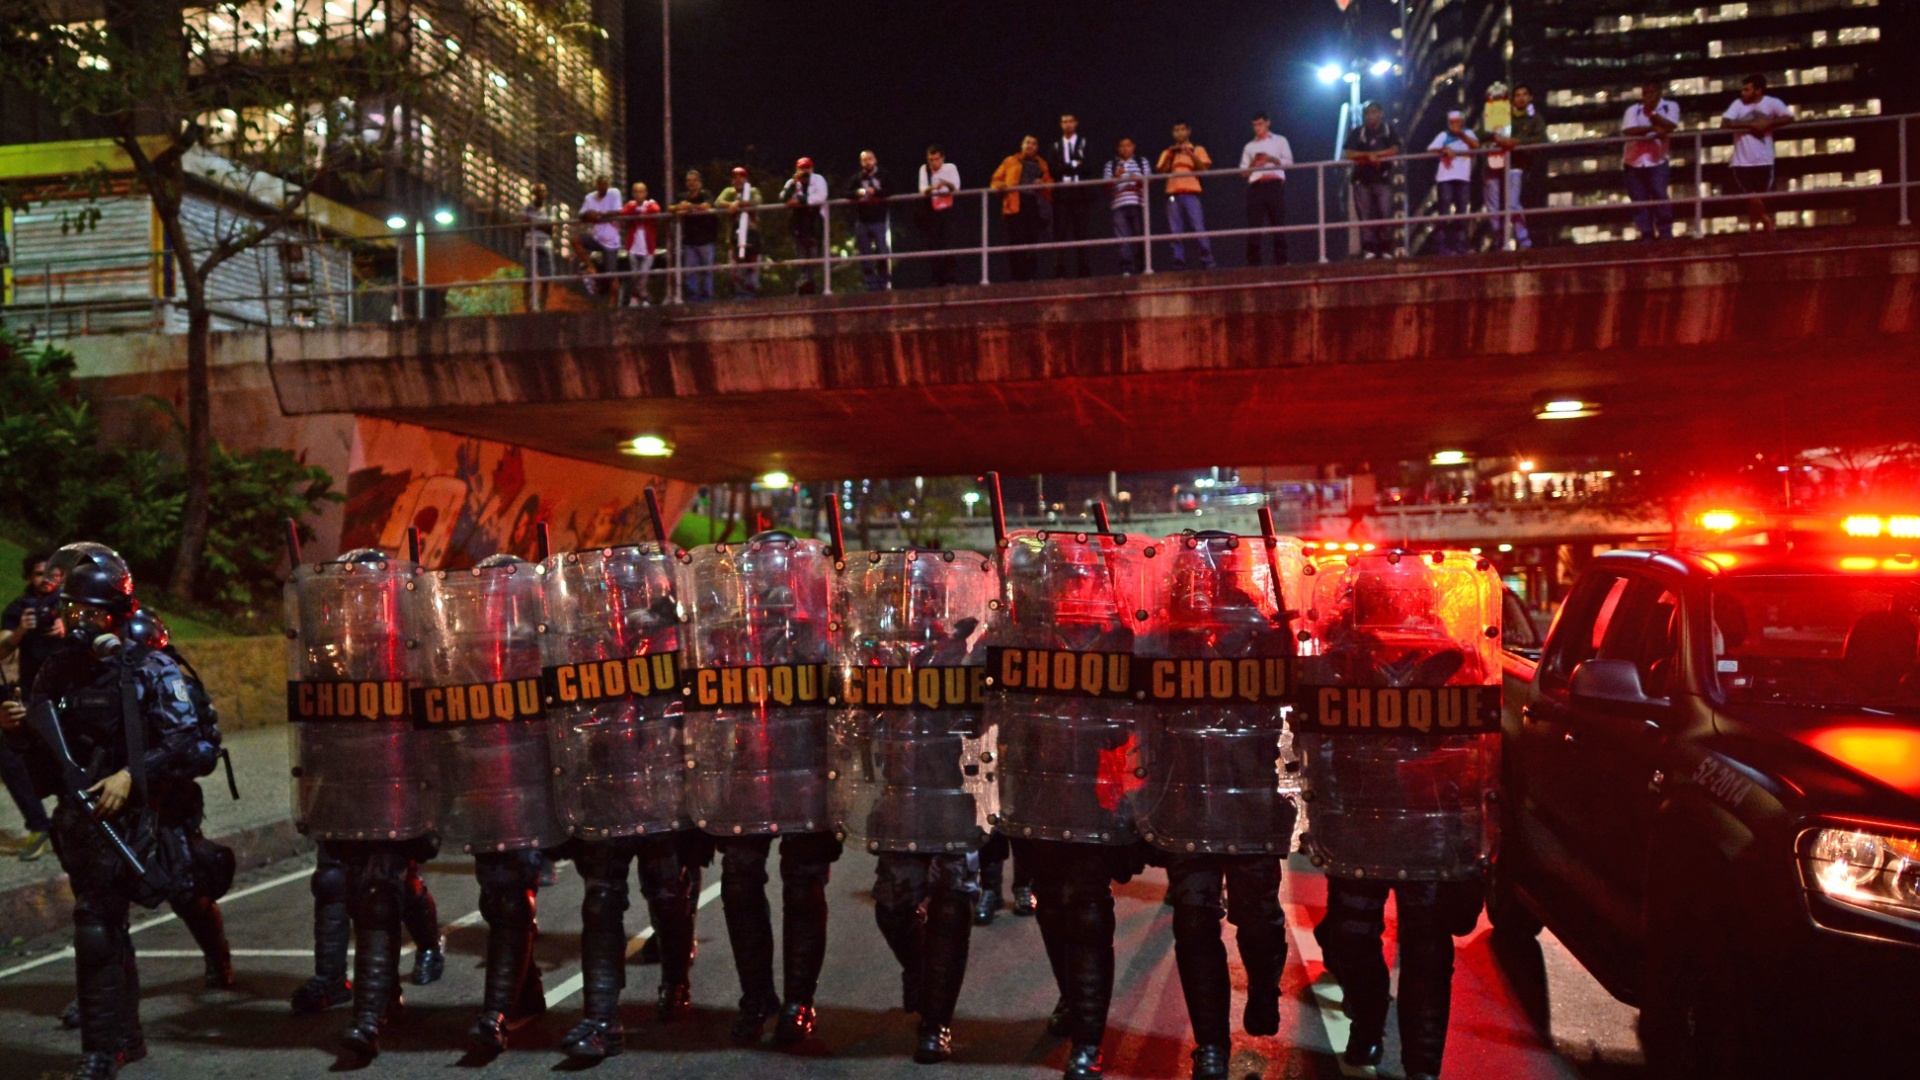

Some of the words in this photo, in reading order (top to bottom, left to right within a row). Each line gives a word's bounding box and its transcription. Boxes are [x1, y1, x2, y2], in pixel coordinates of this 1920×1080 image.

[557, 653, 676, 701] CHOQU
[843, 667, 985, 709] CHOQUE
[1002, 649, 1130, 696] CHOQU
[1153, 659, 1286, 701] CHOQU
[299, 682, 411, 720] CHOQU
[425, 679, 539, 722] CHOQU
[1318, 687, 1483, 732] CHOQUE
